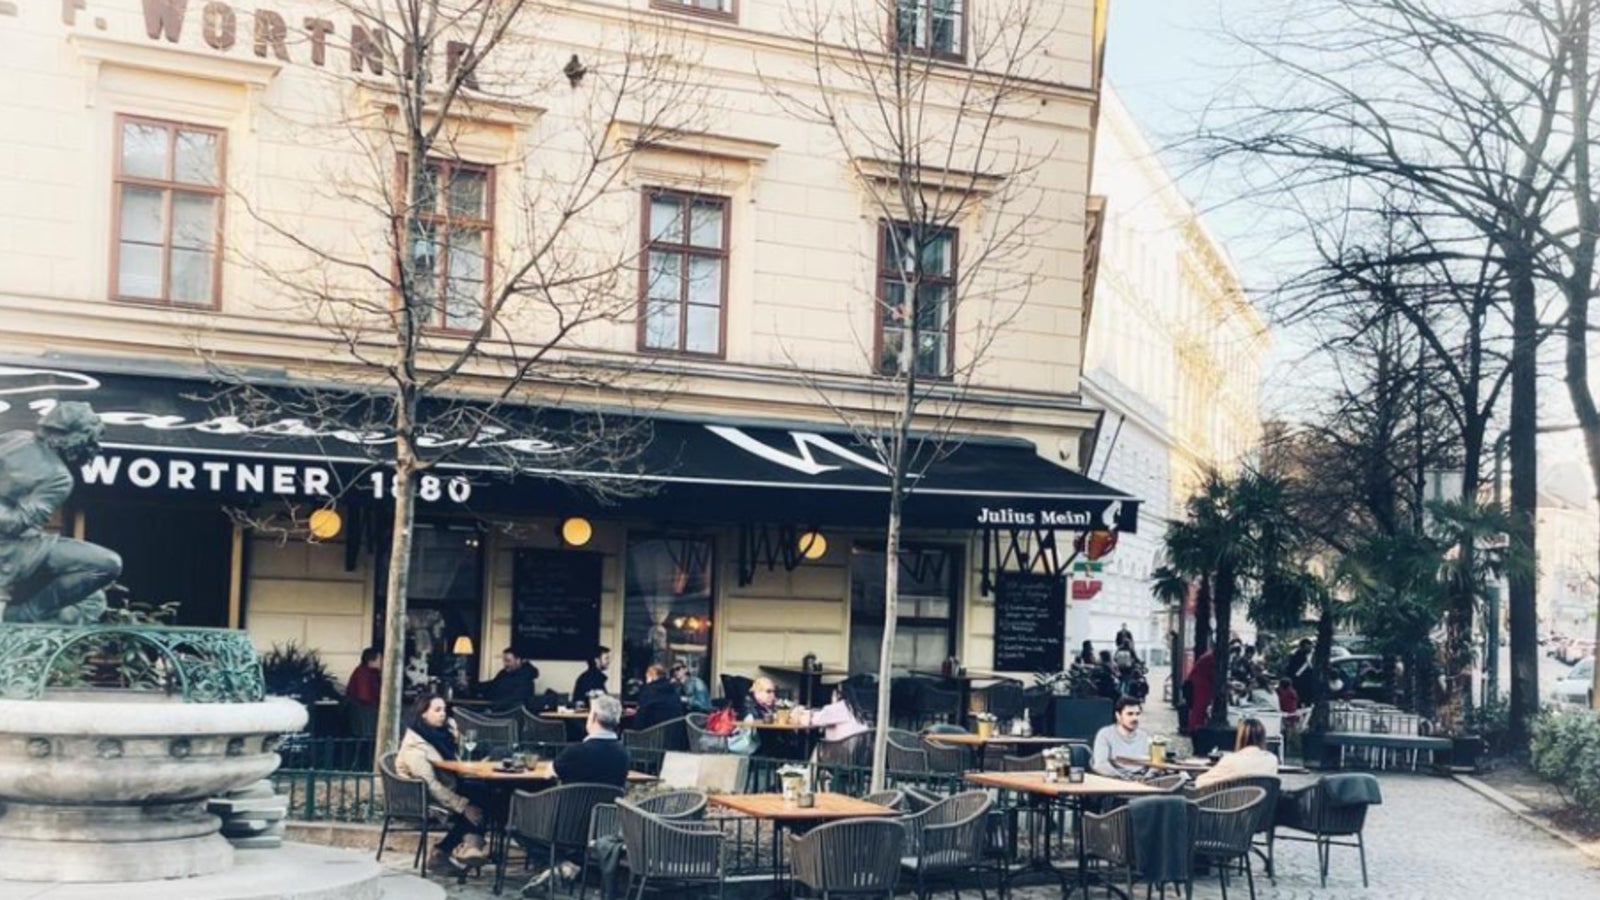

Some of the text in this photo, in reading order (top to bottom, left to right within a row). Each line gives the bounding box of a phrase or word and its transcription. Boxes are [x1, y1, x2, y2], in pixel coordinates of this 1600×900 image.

[81, 455, 330, 496] WORTNER
[977, 508, 1092, 526] Julius Meinl
